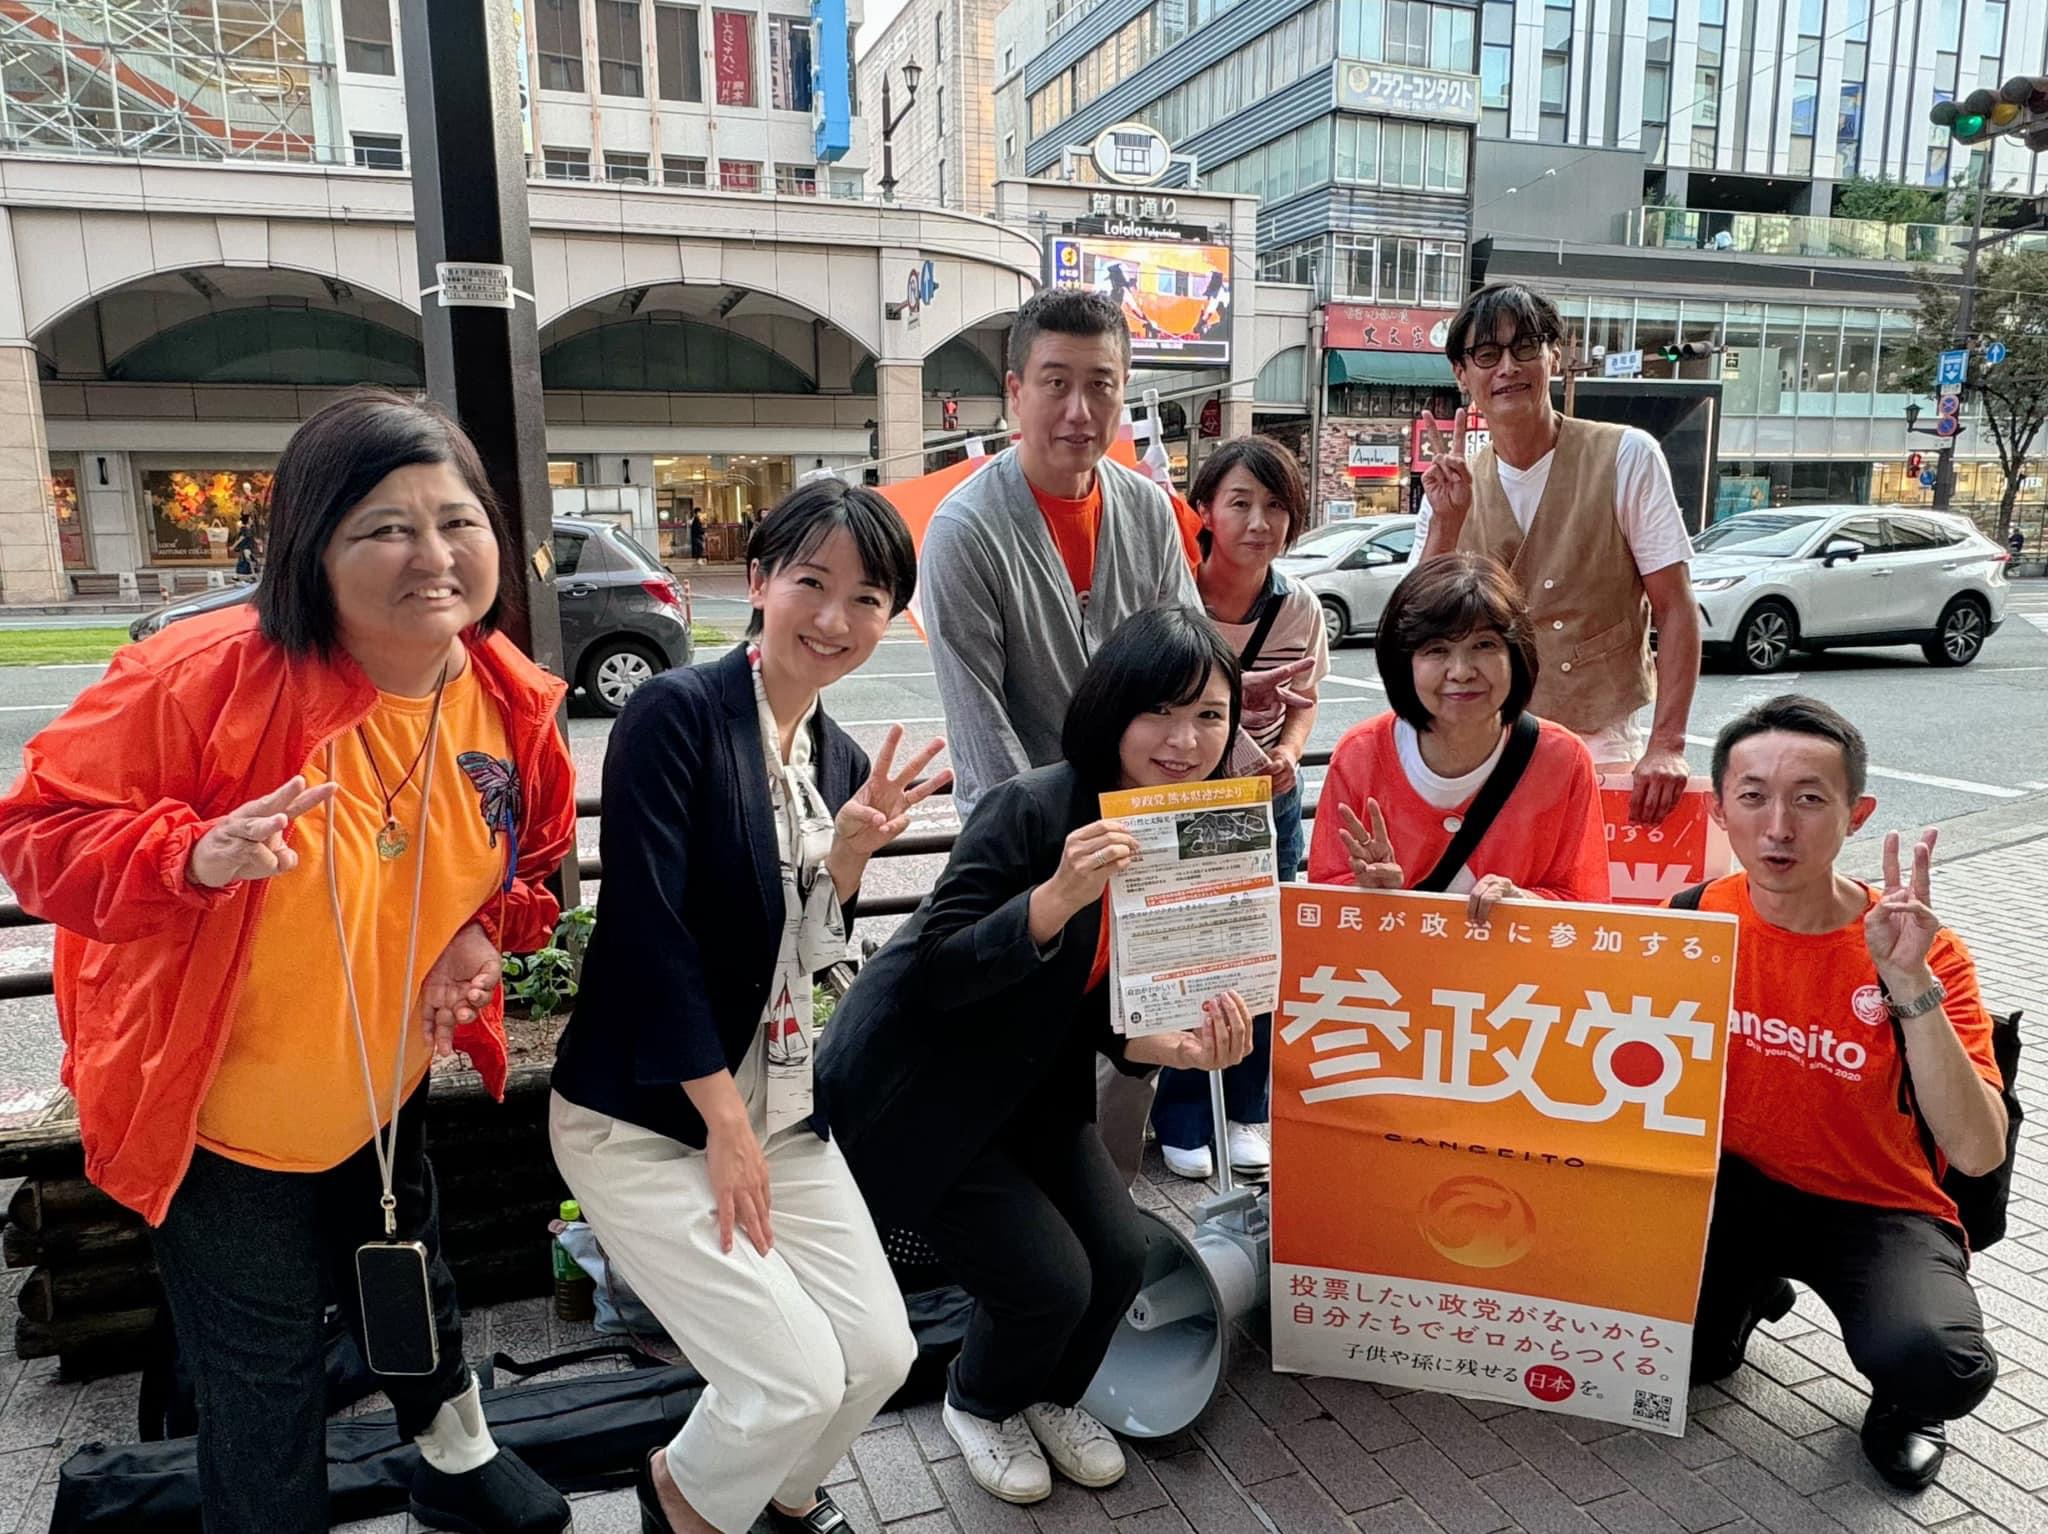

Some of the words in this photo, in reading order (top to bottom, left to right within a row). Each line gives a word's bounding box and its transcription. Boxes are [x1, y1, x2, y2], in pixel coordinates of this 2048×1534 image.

[1370, 70, 1473, 108] フラワーコンタクト
[1297, 903, 1721, 964] 国民が政治に参加する。
[1279, 965, 1715, 1137] 参政党
[1834, 1067, 1862, 1082] 2020
[1290, 1274, 1674, 1354] 投票したい政党がないから、
[1293, 1302, 1670, 1382] 自分たちでゼロからつくる。
[1343, 1343, 1604, 1400] 子供や孫に残せる日本を。
